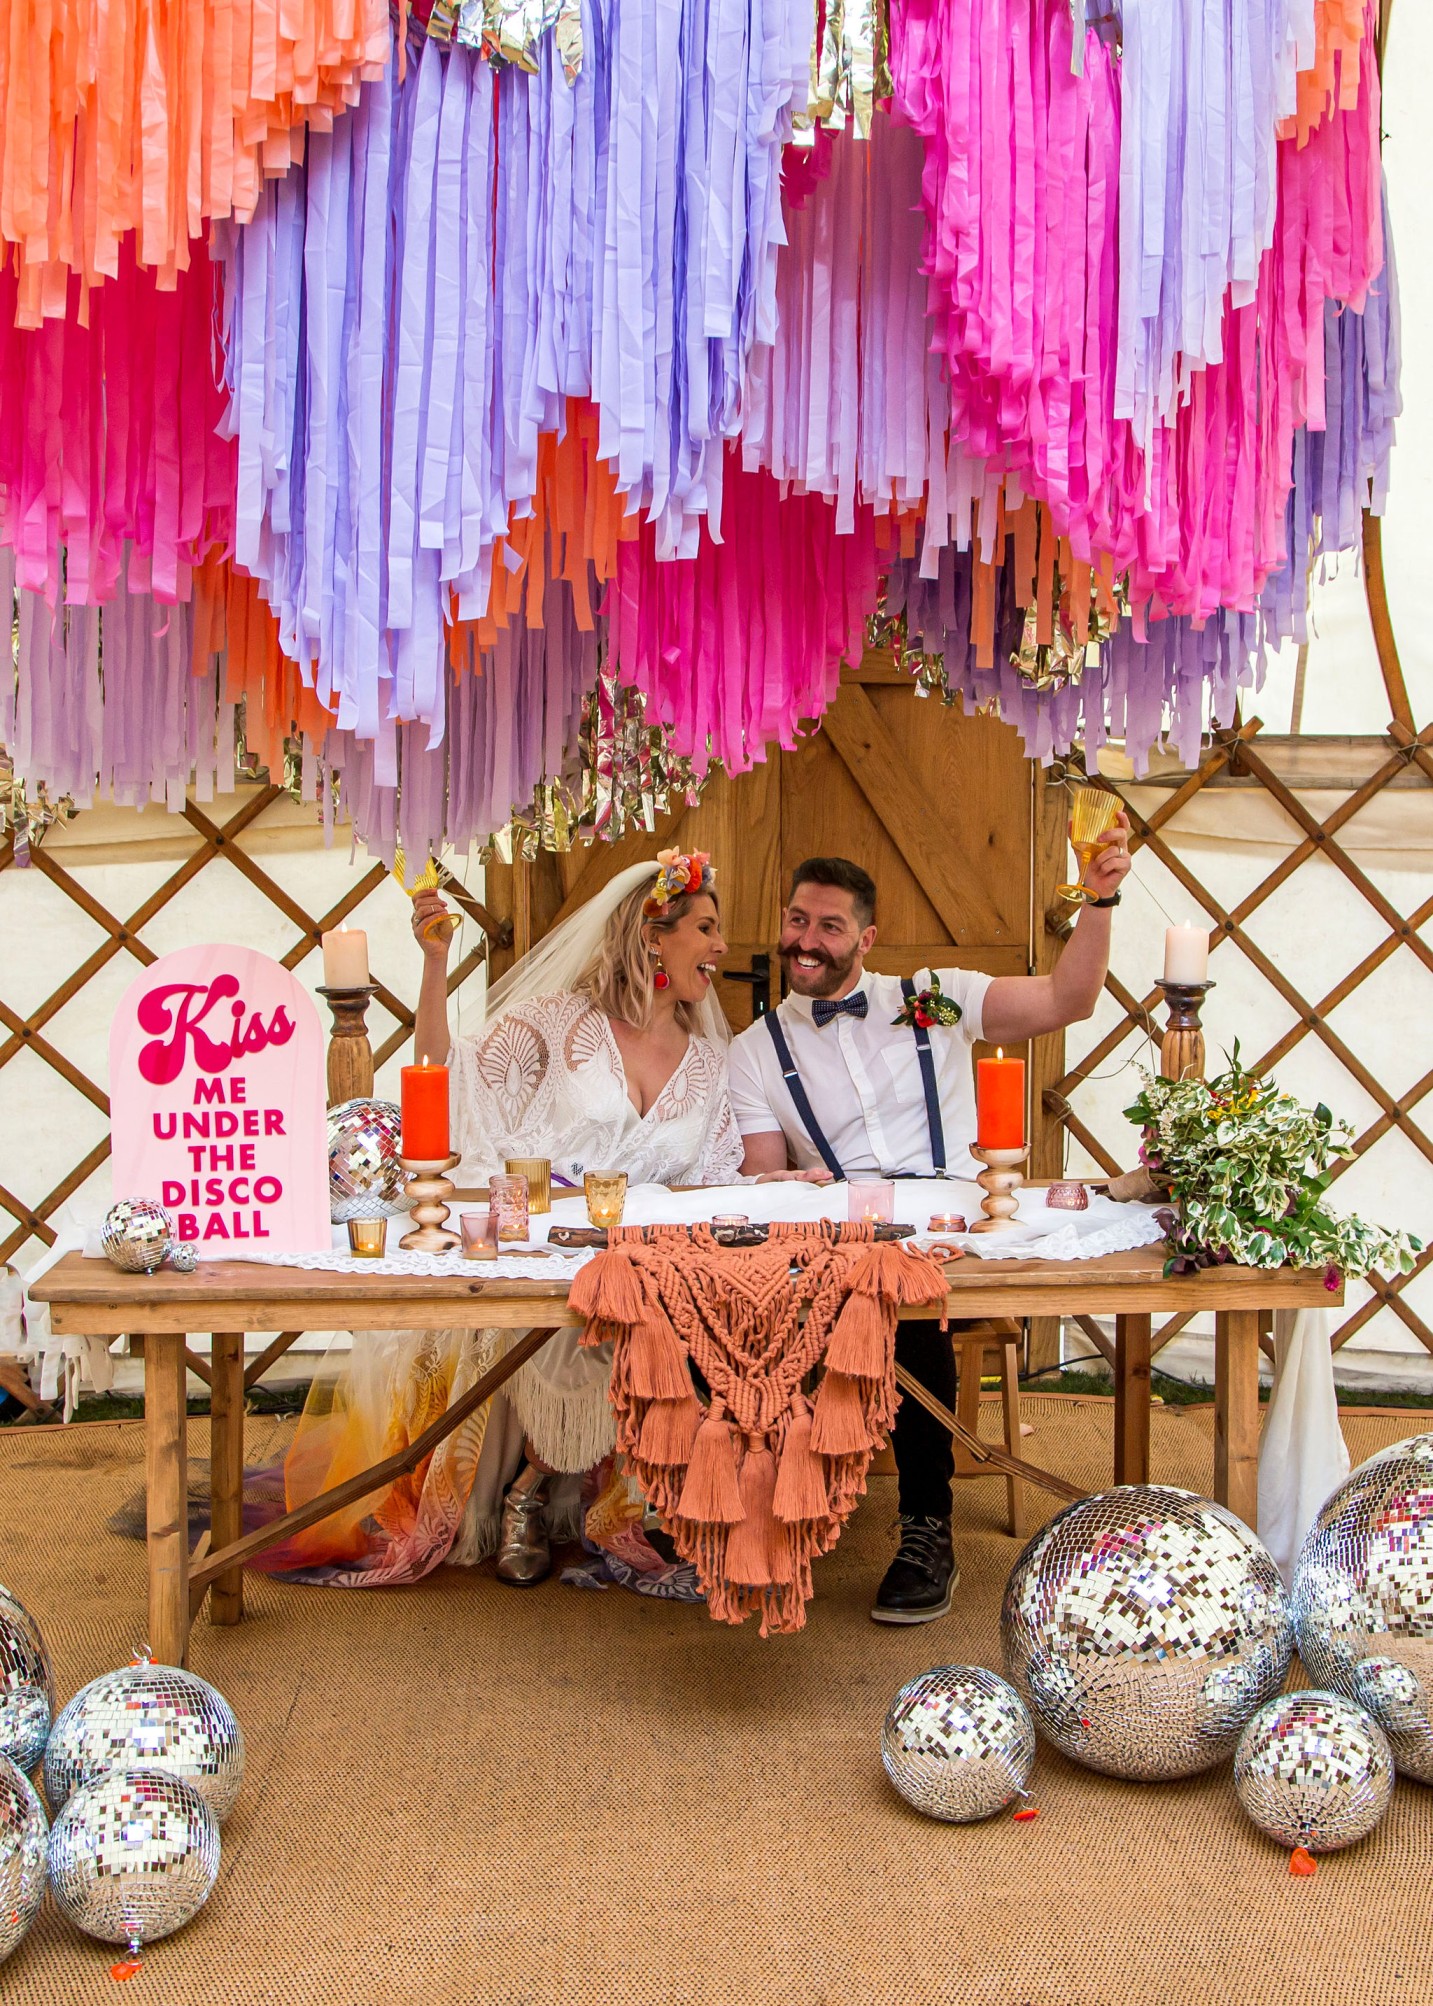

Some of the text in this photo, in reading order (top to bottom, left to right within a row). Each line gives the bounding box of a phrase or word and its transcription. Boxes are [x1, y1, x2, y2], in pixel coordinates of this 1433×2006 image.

[138, 974, 296, 1085] Kiss
[193, 1077, 247, 1104] ME
[153, 1110, 286, 1140] UNDER
[188, 1144, 256, 1172] THE
[162, 1176, 283, 1208] DISCO
[178, 1211, 270, 1241] BALL
